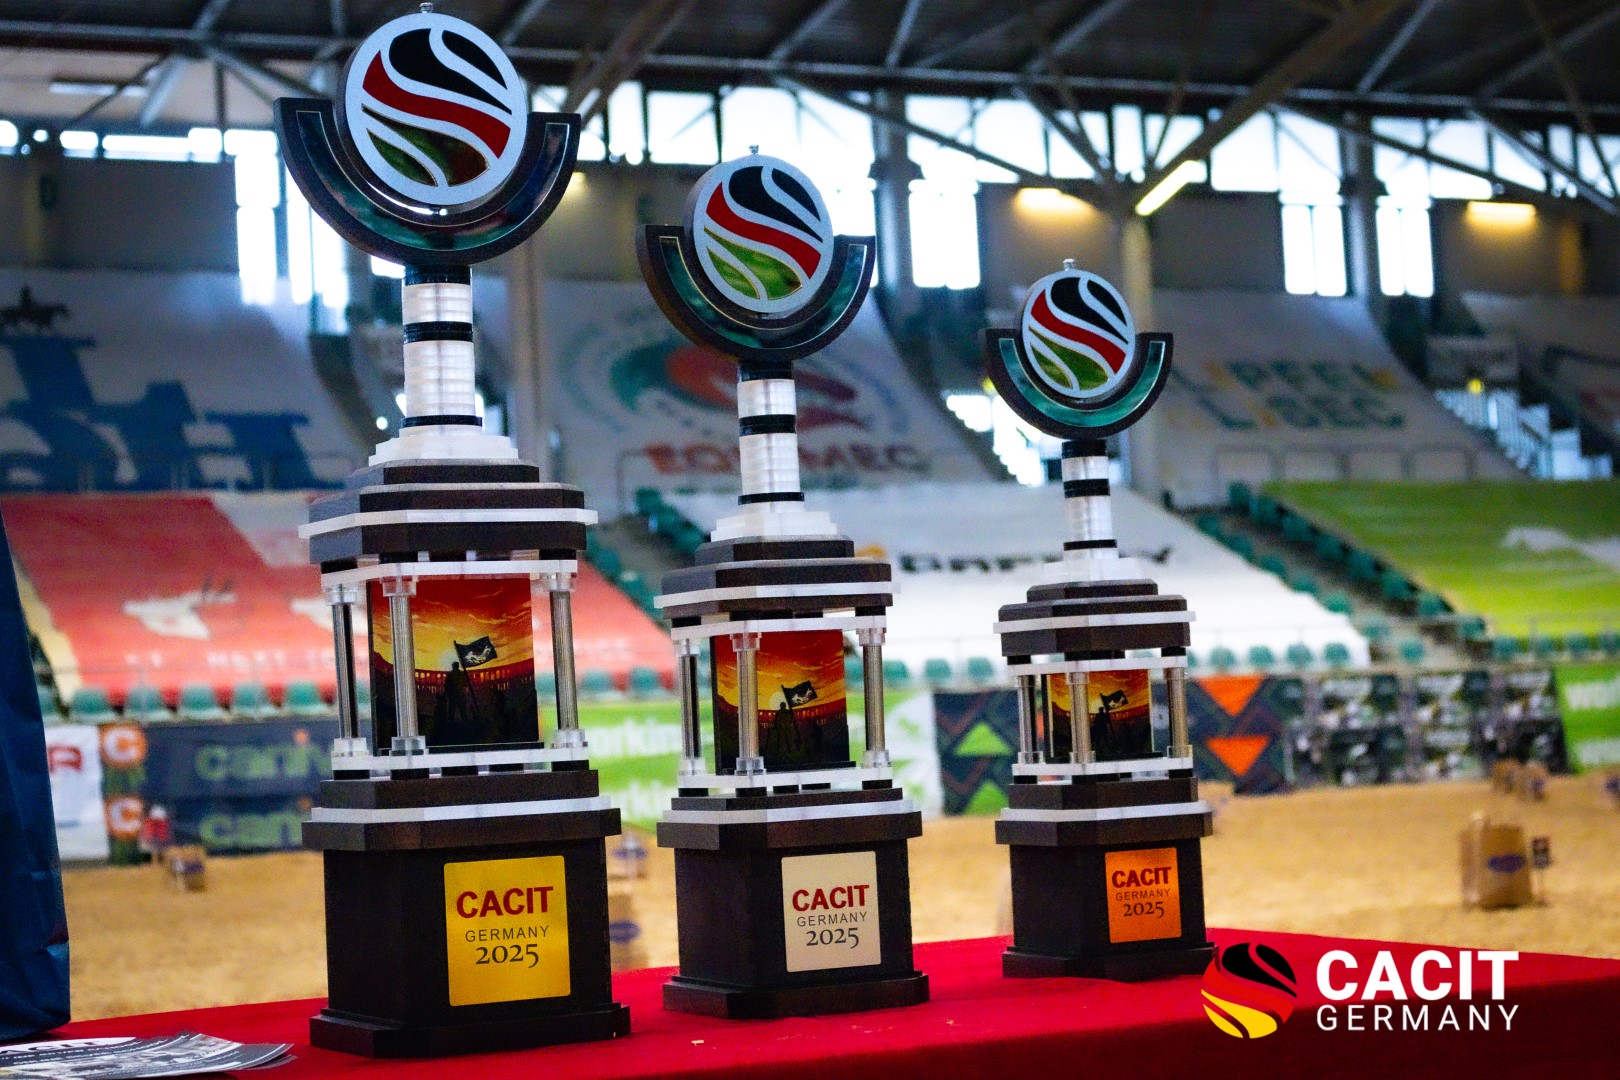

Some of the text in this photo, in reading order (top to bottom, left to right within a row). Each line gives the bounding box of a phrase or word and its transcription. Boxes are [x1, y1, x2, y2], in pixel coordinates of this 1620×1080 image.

[1112, 866, 1172, 889] CACIT
[456, 886, 554, 919] CACIT
[792, 884, 870, 912] CACIT
[1115, 888, 1171, 901] GERMANY
[796, 911, 868, 927] GERMANY
[1123, 901, 1165, 919] 2025
[465, 925, 549, 942] GERMANY
[806, 927, 860, 949] 2025
[475, 943, 539, 969] 2025
